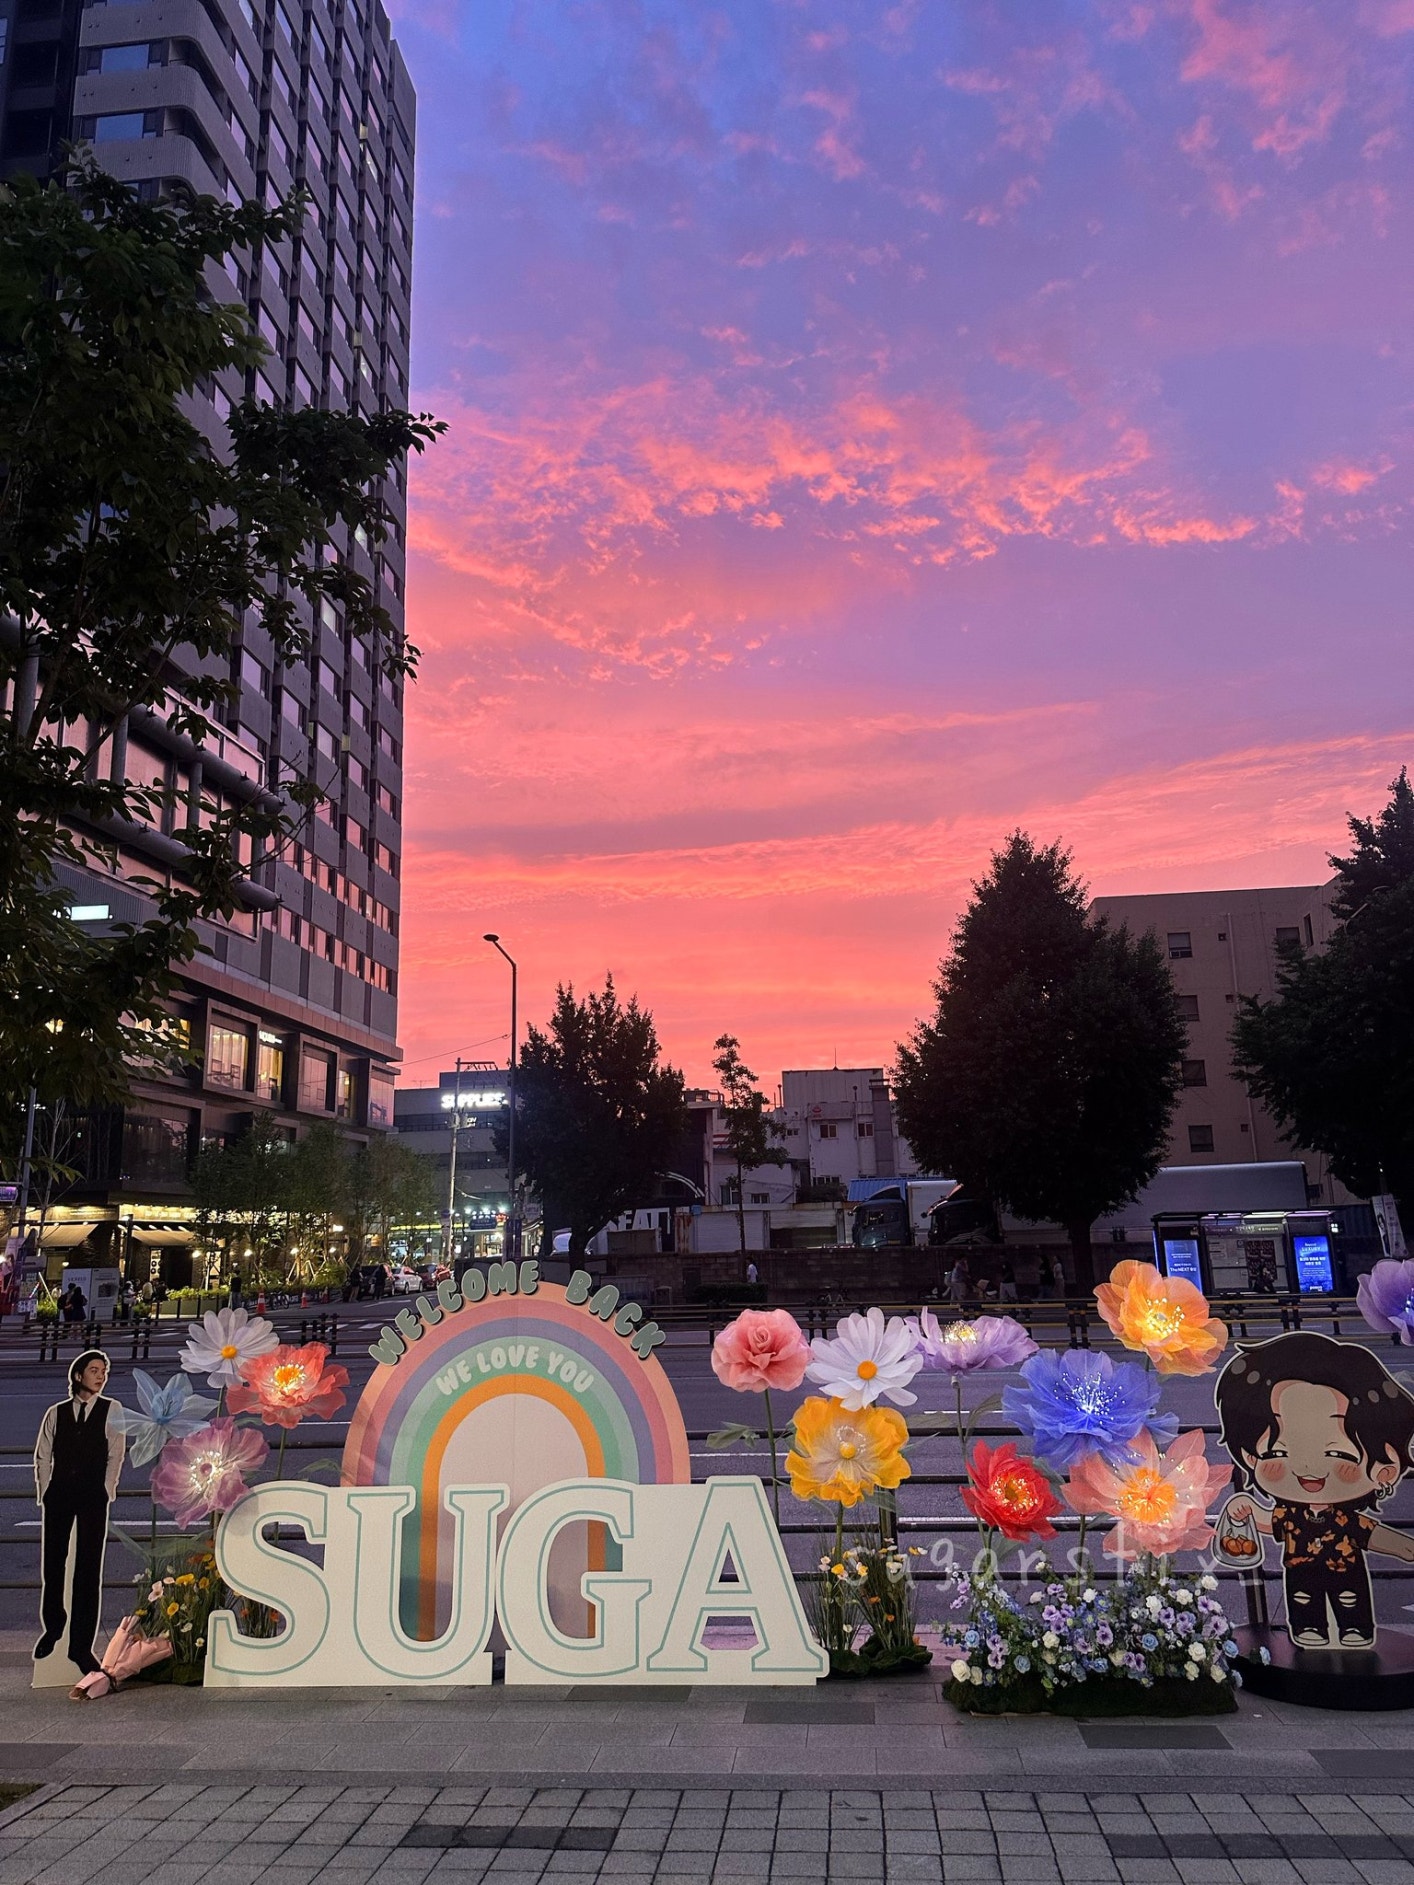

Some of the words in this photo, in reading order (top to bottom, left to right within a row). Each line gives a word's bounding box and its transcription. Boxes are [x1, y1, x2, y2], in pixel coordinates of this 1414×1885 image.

[368, 1260, 539, 1366] WELCOME
[565, 1269, 666, 1359] BACK
[435, 1364, 472, 1396] WE
[476, 1344, 541, 1374] LOVE
[547, 1350, 595, 1394] YOU
[205, 1476, 831, 1686] SUGA
